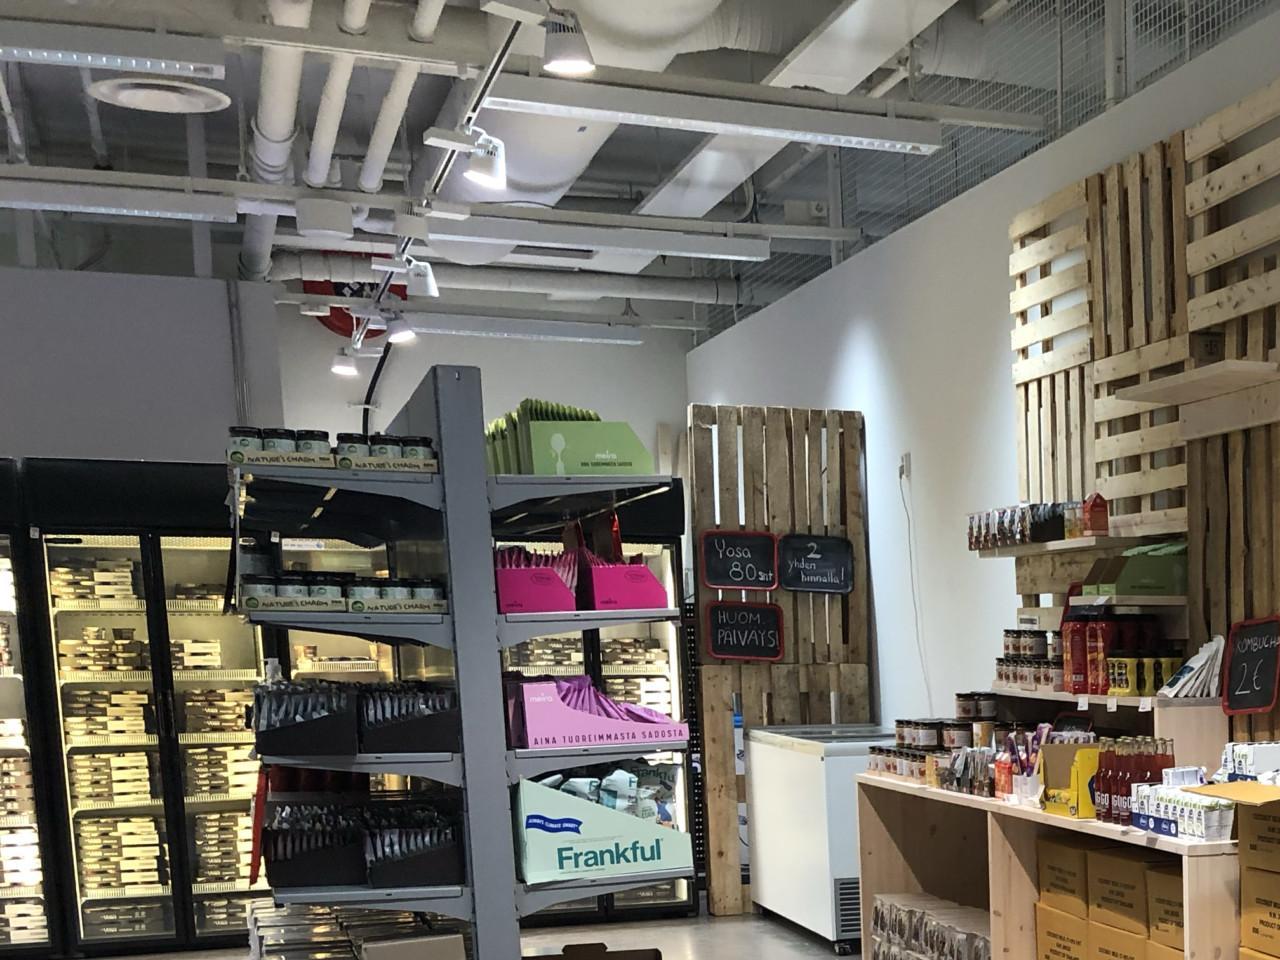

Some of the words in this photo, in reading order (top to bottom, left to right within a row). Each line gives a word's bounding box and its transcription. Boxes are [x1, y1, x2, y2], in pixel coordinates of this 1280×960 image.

[714, 539, 751, 558] Yosa
[806, 542, 822, 558] 2
[729, 561, 756, 581] 80
[788, 558, 816, 577] yhden
[801, 567, 844, 585] hinnalla!
[1234, 635, 1280, 653] KOMBUCHA
[1234, 658, 1264, 695] 2€
[534, 737, 557, 746] AINA
[563, 732, 637, 744] TUOREIMMASTA
[641, 729, 684, 740] SADOSTA
[557, 838, 662, 870] Frankful
